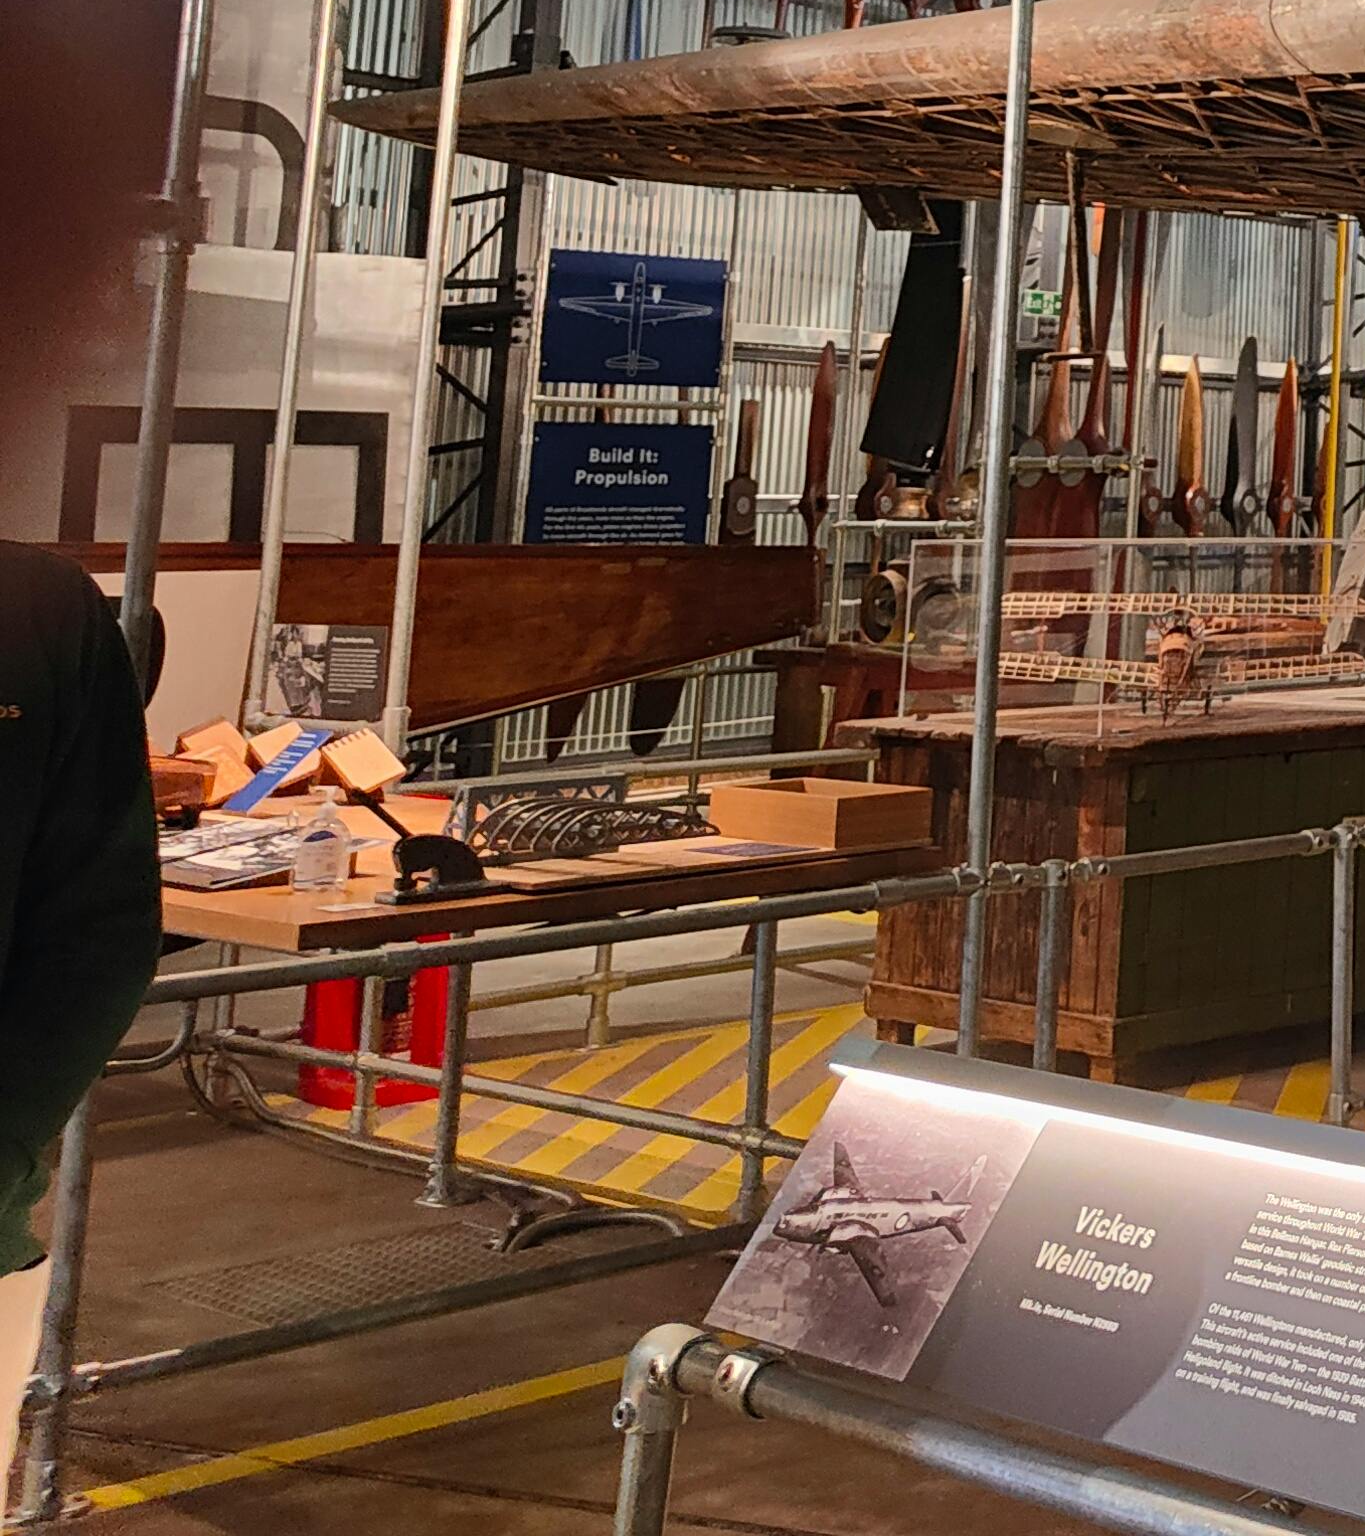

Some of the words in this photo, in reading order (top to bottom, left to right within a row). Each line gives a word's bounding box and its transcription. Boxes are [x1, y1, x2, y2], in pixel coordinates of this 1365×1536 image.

[589, 448, 634, 465] Build
[638, 448, 659, 464] It:
[575, 469, 669, 487] Propulsion
[1256, 1211, 1283, 1223] service
[1282, 1215, 1323, 1231] throughout
[1323, 1222, 1347, 1236] World
[1345, 1227, 1362, 1239] War
[1265, 1194, 1280, 1205] The
[1280, 1197, 1317, 1213] Wellington
[1318, 1207, 1333, 1216] was
[1333, 1208, 1346, 1219] the
[1345, 1212, 1363, 1224] only
[1075, 1206, 1156, 1249] Vickers
[1249, 1223, 1258, 1234] in
[1257, 1226, 1272, 1237] this
[1035, 1240, 1153, 1295] Wellington
[1241, 1239, 1265, 1253] based
[1263, 1246, 1274, 1254] on
[1321, 1259, 1355, 1273] geodetic
[1234, 1256, 1264, 1270] versatile
[1296, 1269, 1314, 1281] took
[1313, 1275, 1325, 1283] on
[1330, 1278, 1360, 1291] number
[1261, 1278, 1291, 1293] bomber
[1289, 1287, 1306, 1297] and
[1304, 1288, 1322, 1301] then
[1322, 1295, 1333, 1304] on
[1332, 1297, 1362, 1310] coastal
[1063, 1309, 1094, 1326] Number
[1209, 1303, 1221, 1314] Of
[1219, 1306, 1232, 1317] the
[1348, 1339, 1365, 1352] only
[1191, 1334, 1225, 1354] bombing
[1274, 1355, 1291, 1368] War
[1291, 1359, 1307, 1373] Two
[1317, 1366, 1331, 1379] the
[1201, 1318, 1216, 1331] This
[1247, 1332, 1270, 1345] active
[1269, 1338, 1297, 1352] service
[1296, 1342, 1331, 1359] included
[1328, 1353, 1344, 1364] one
[1343, 1355, 1356, 1366] of
[1191, 1372, 1220, 1390] training
[1240, 1386, 1258, 1397] and
[1256, 1390, 1272, 1401] was
[1271, 1391, 1295, 1409] finally
[1250, 1370, 1267, 1381] was
[1294, 1378, 1303, 1390] in
[1302, 1381, 1322, 1395] Loch
[1341, 1391, 1351, 1403] in
